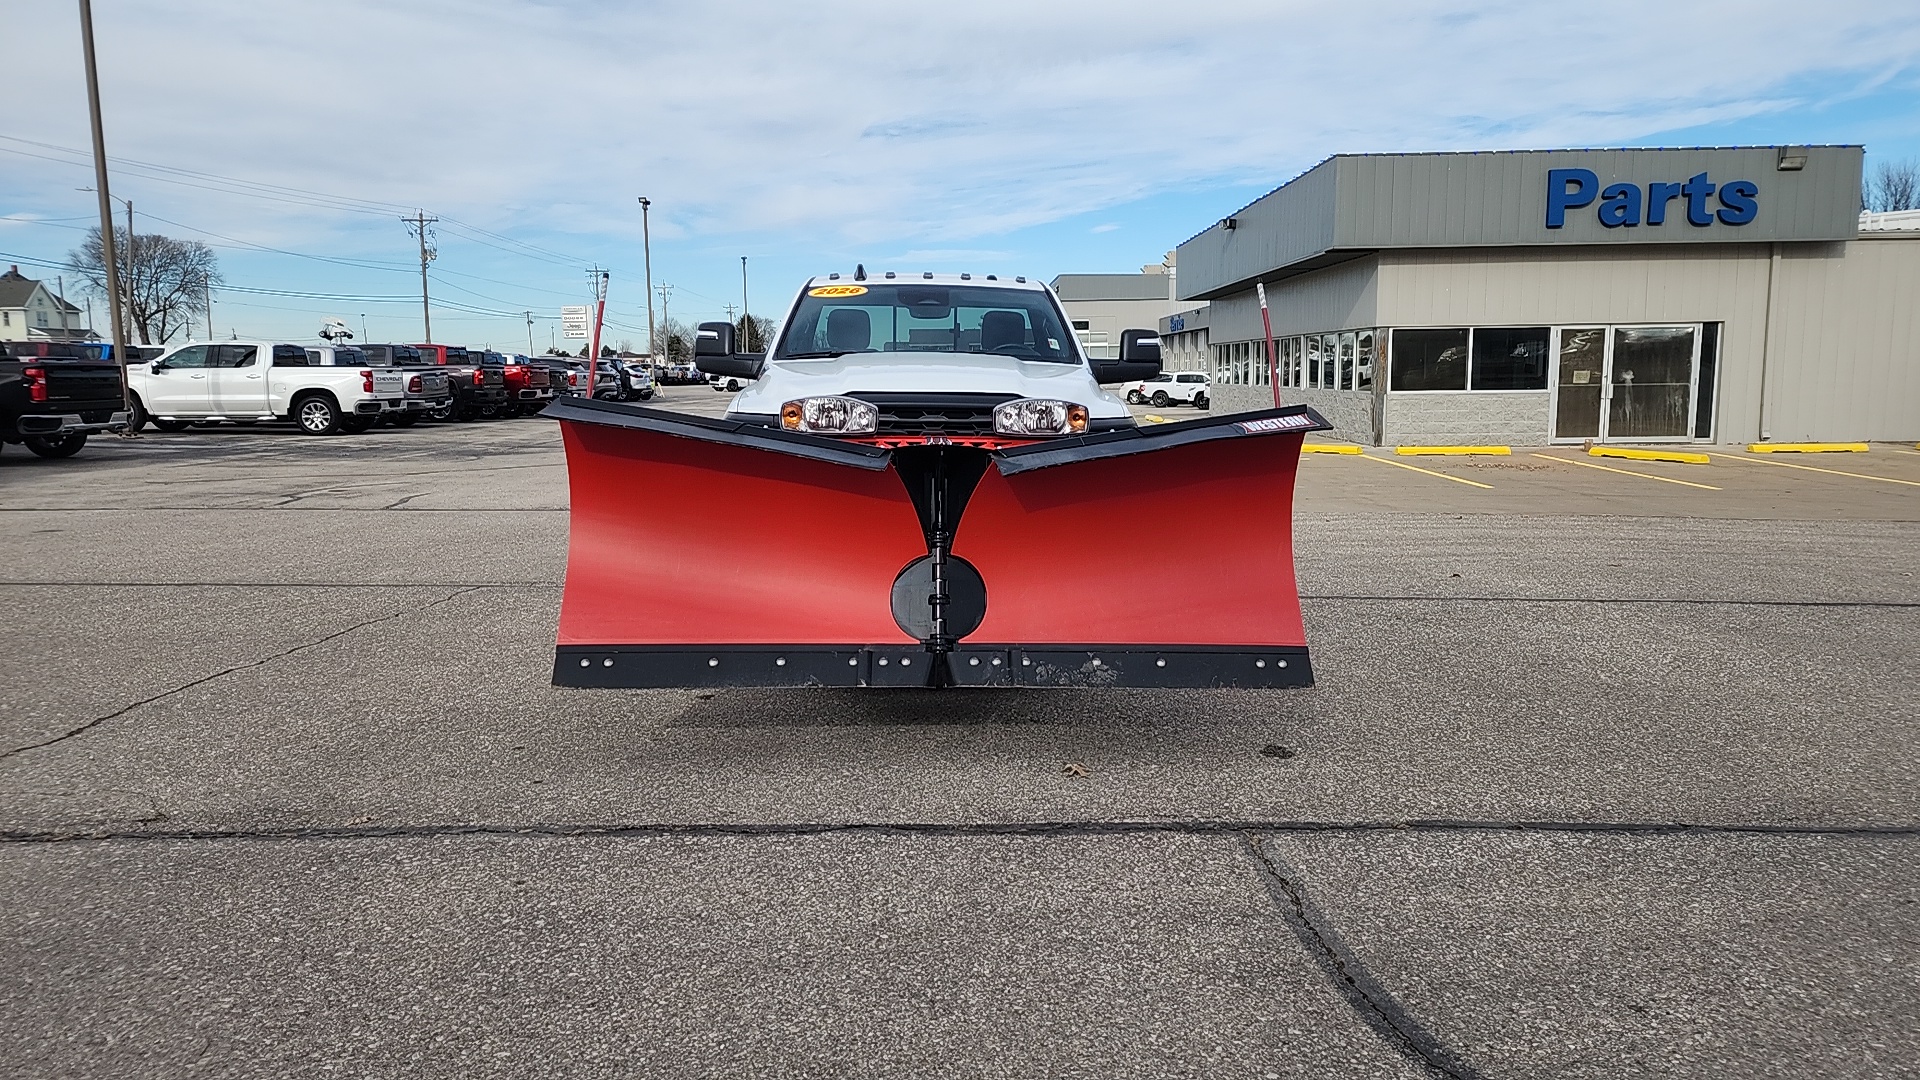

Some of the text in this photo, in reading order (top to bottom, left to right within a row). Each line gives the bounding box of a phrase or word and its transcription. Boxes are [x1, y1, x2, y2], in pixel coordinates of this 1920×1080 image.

[1546, 168, 1759, 228] Parts
[814, 287, 863, 296] 2026
[1242, 414, 1311, 432] WESTERN
